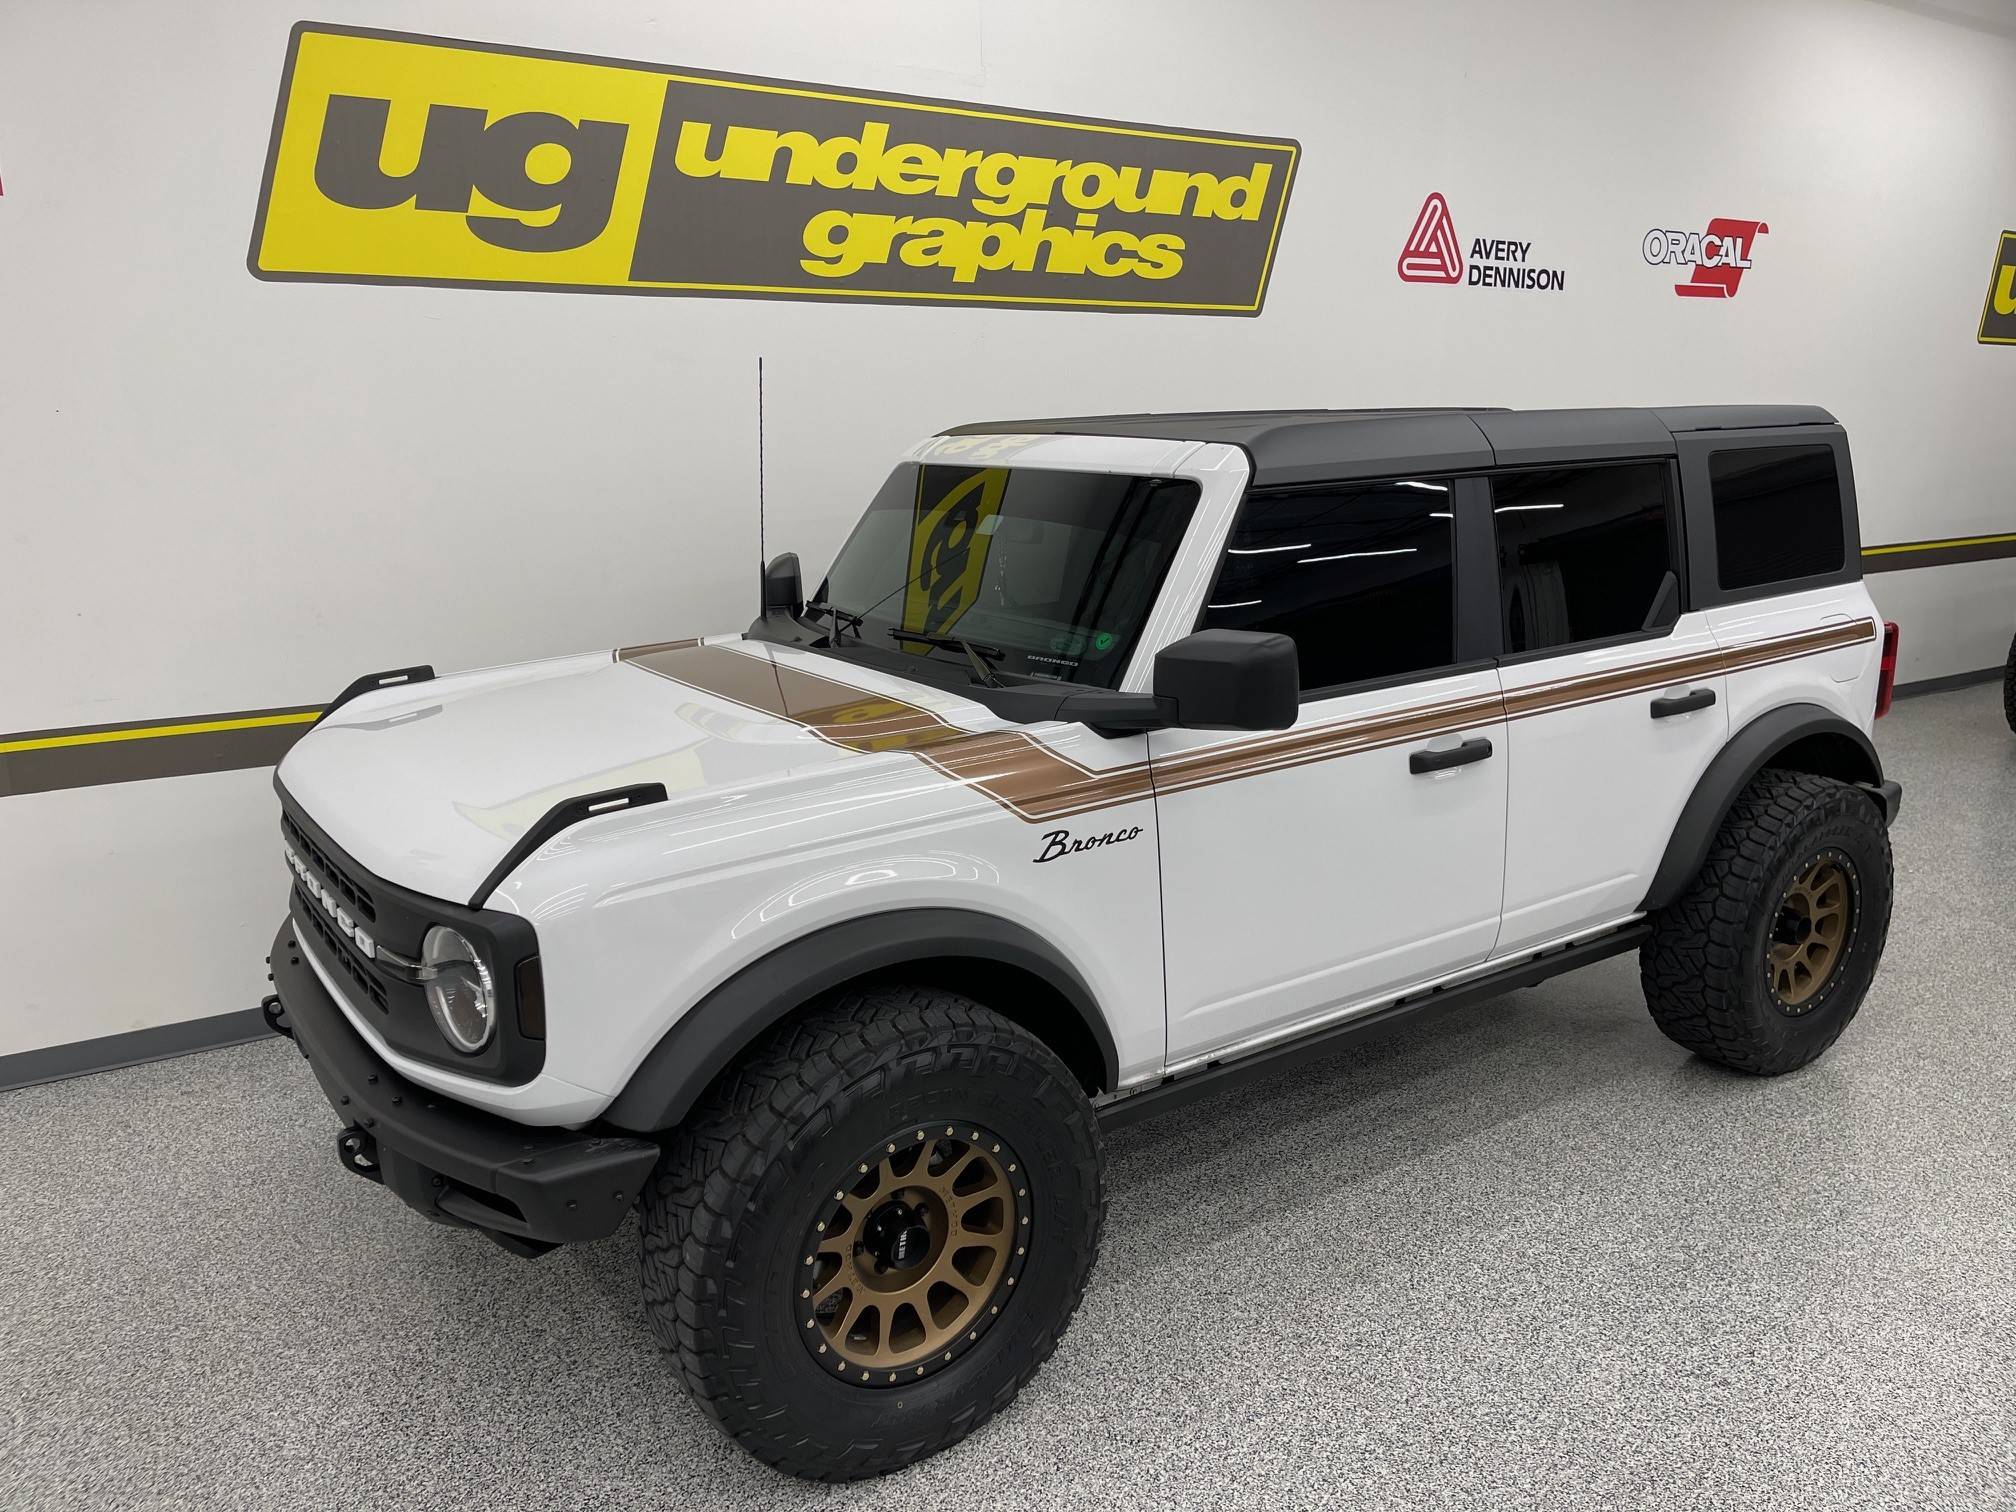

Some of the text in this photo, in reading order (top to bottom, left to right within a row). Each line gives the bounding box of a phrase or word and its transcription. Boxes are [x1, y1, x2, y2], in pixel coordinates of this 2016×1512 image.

[314, 94, 629, 253] ug
[675, 121, 1272, 221] underground
[800, 209, 1186, 282] graphics
[1470, 238, 1532, 262] AVERY
[1643, 228, 1752, 269] ORACAL
[1468, 264, 1565, 290] DENNISON
[1032, 826, 1144, 863] Bronco
